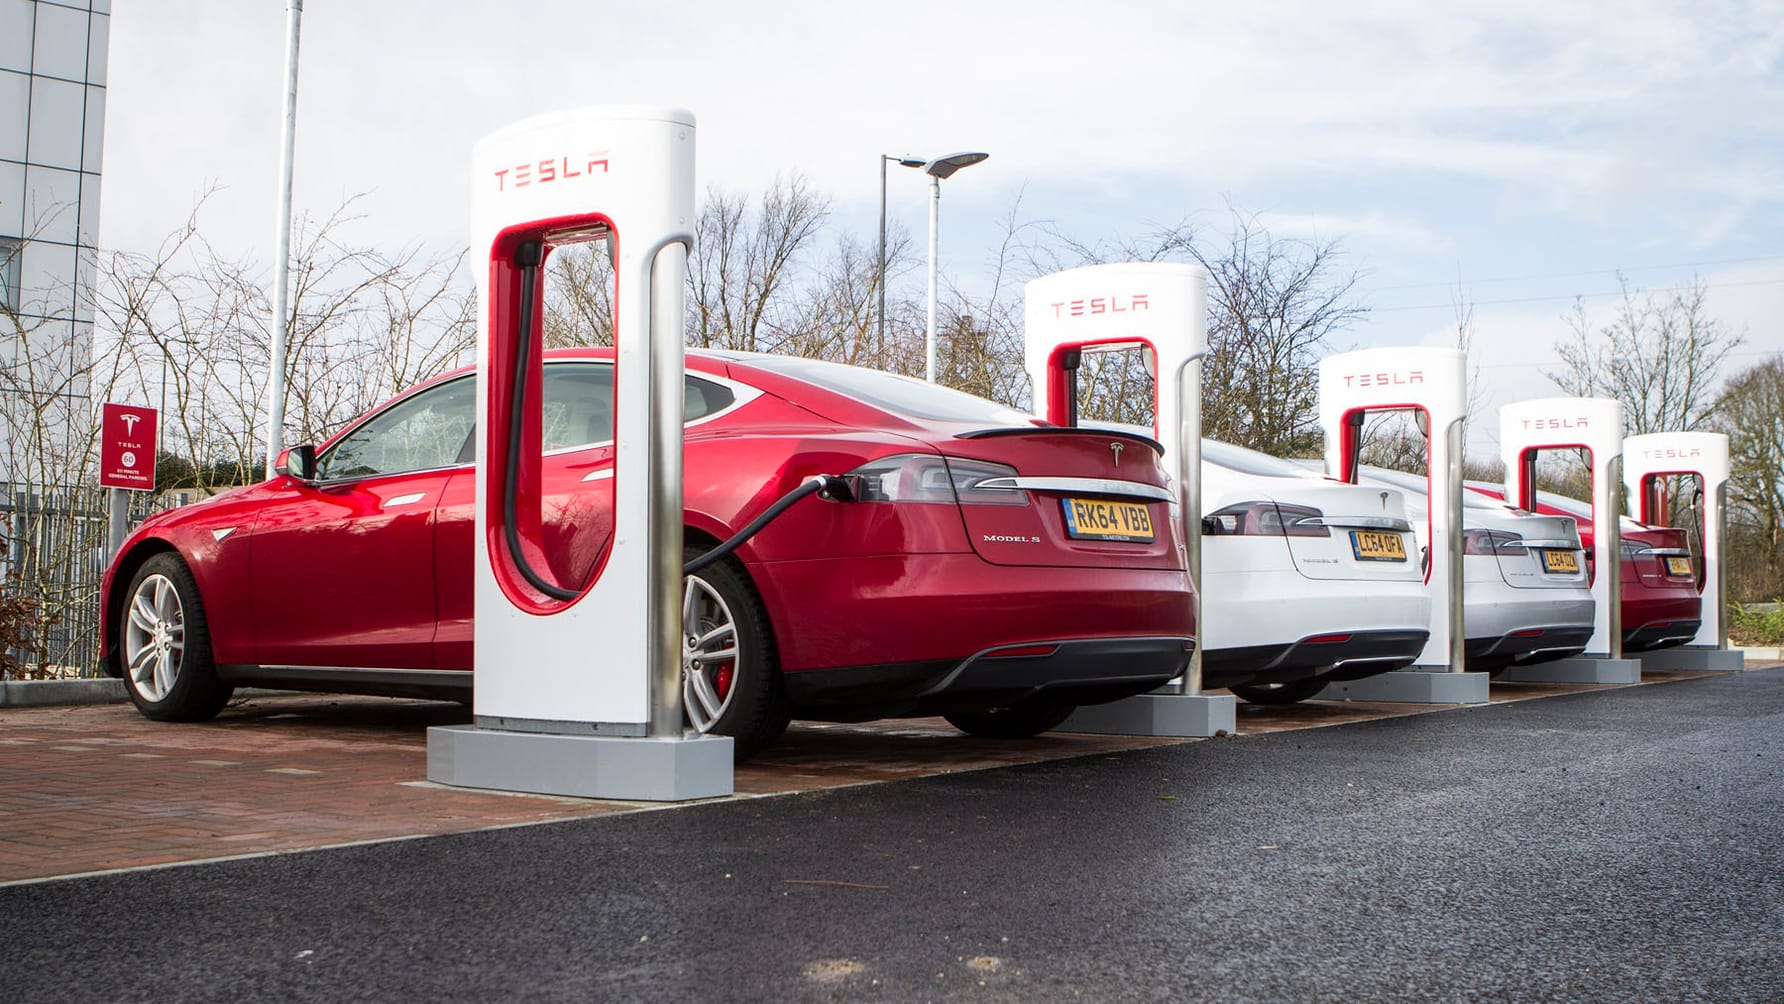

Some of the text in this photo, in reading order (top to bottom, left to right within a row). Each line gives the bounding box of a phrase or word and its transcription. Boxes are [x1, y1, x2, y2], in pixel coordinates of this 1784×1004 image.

[494, 150, 609, 192] TESLA
[1051, 294, 1149, 318] TESLA
[1343, 371, 1424, 388] TESLA
[1521, 417, 1589, 430] TESLA
[1642, 448, 1701, 459] TESLA
[1074, 503, 1151, 532] RK64 VBB
[983, 534, 1029, 542] MODEL
[1357, 533, 1385, 552] LC64
